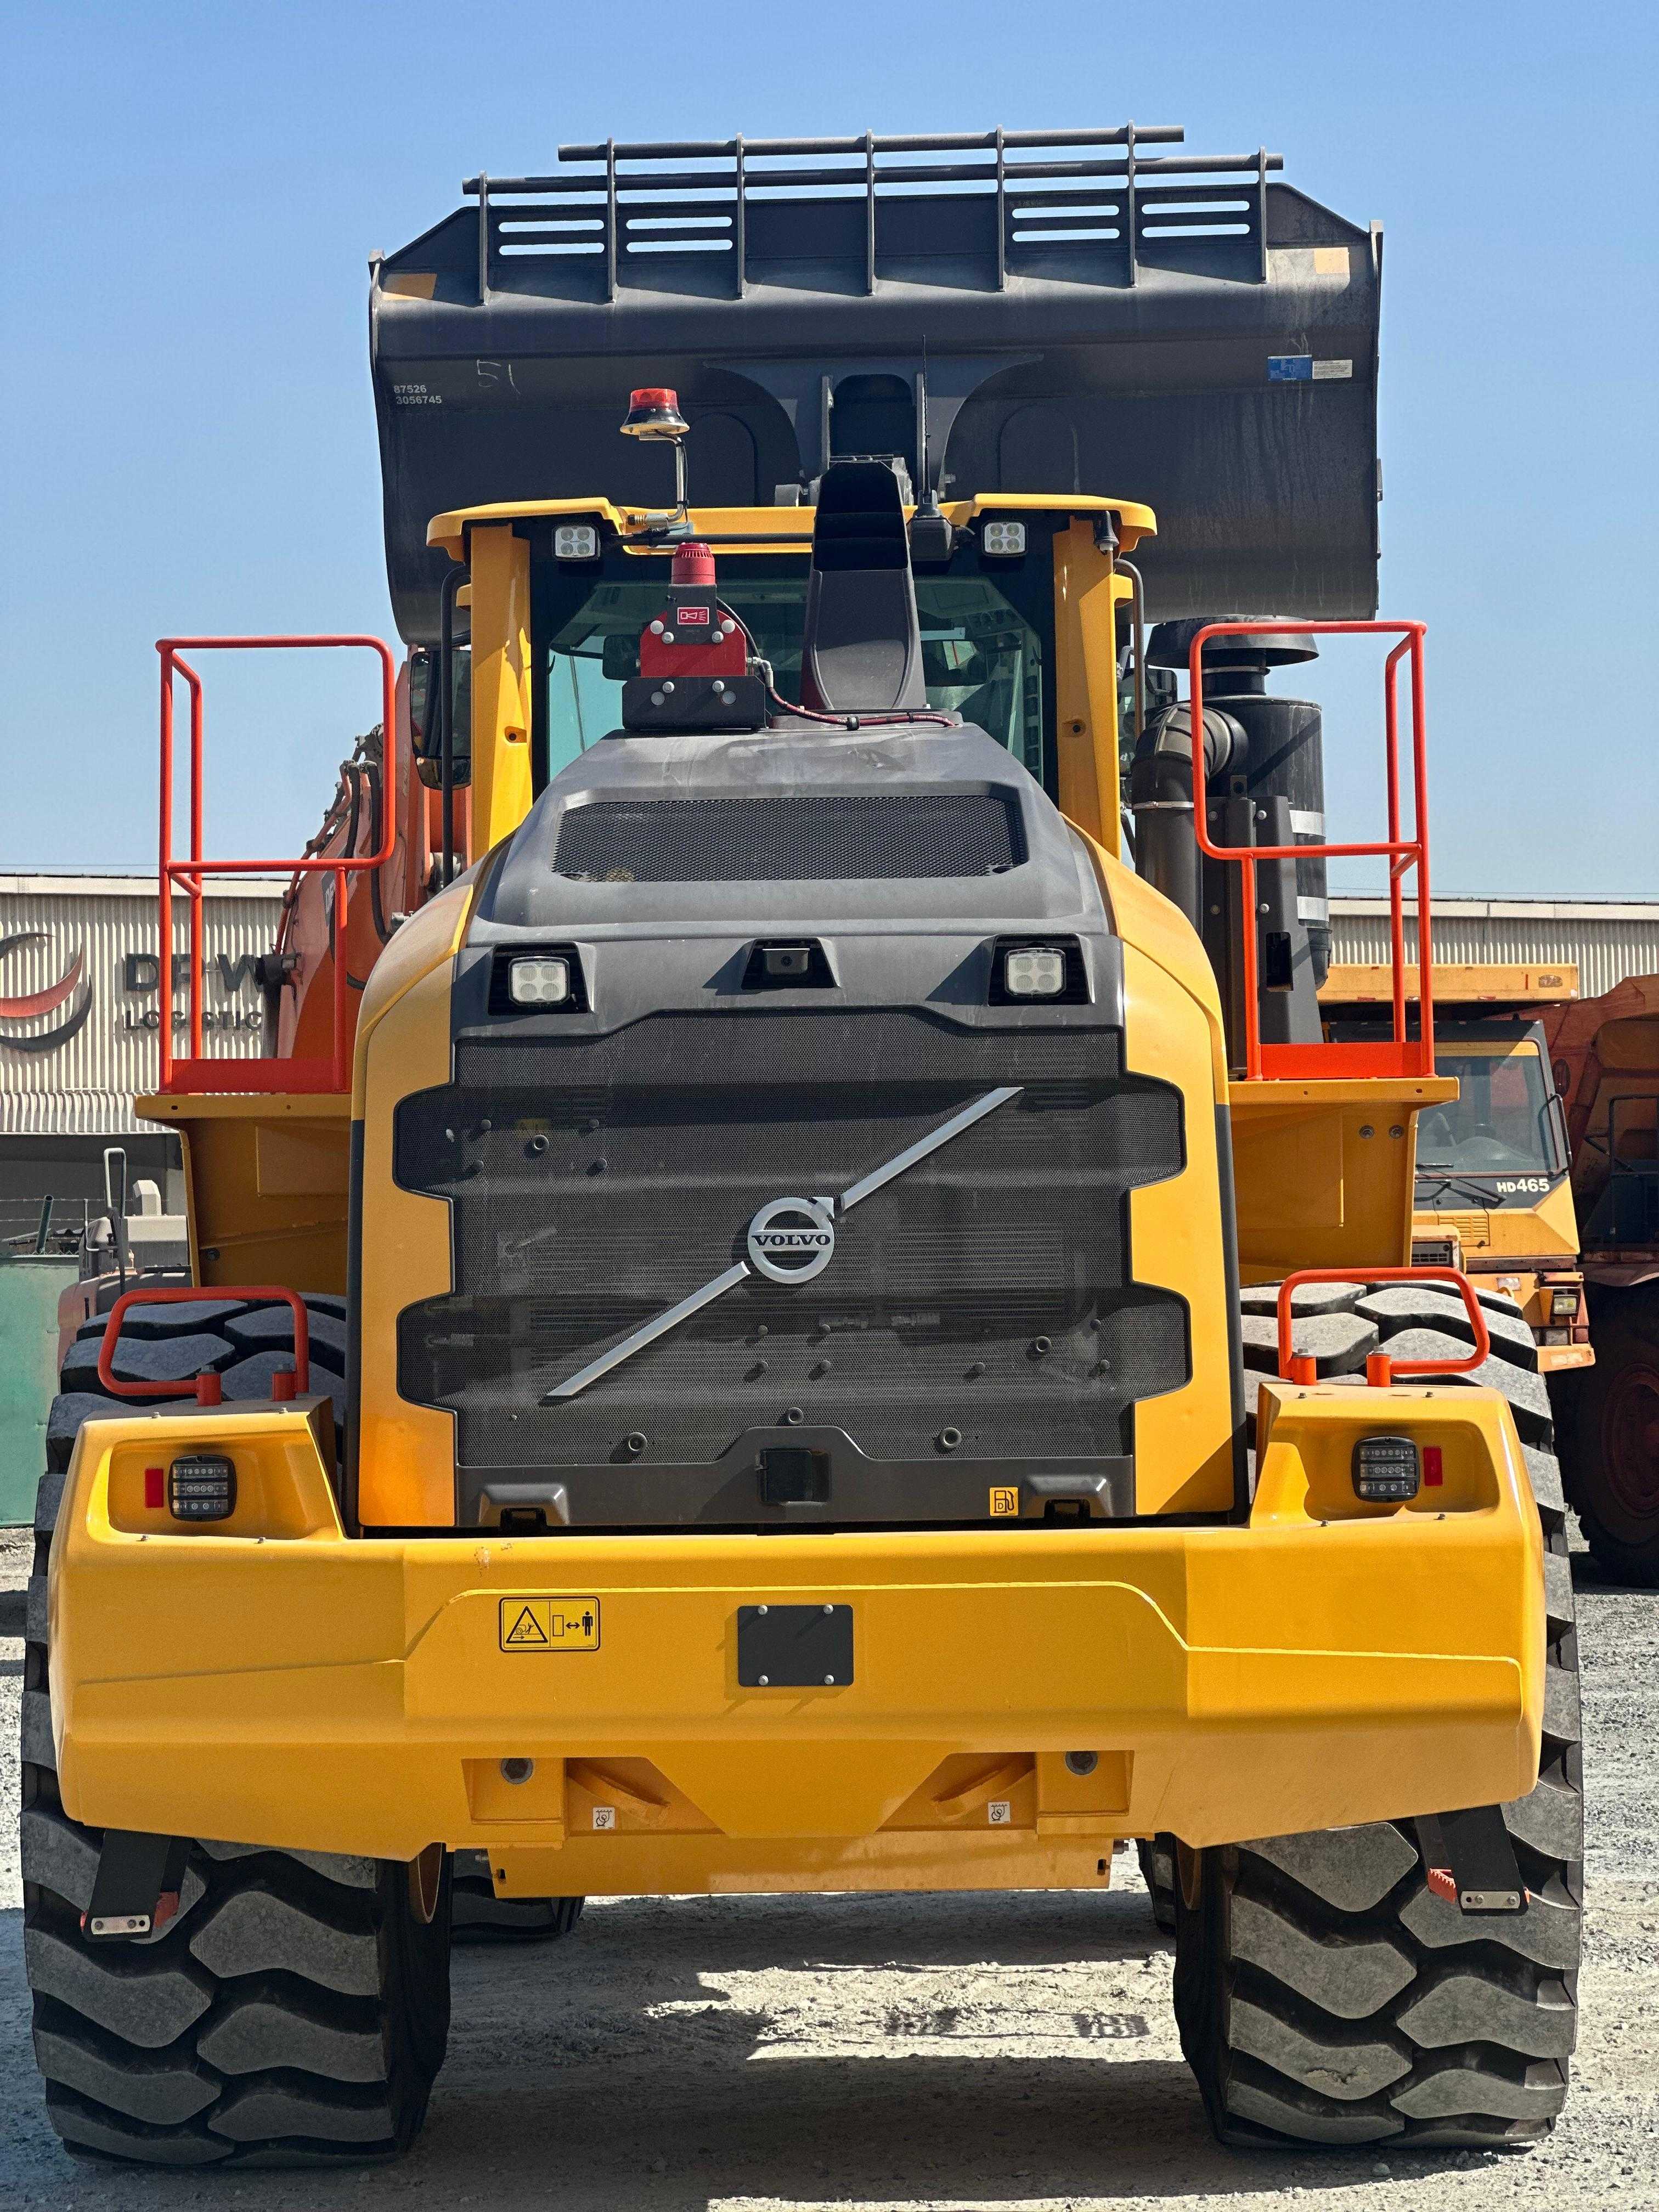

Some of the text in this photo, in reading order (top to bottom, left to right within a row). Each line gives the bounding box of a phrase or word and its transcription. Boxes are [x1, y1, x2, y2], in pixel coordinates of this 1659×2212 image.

[393, 385, 427, 393] 87526
[396, 396, 442, 404] 3056745
[126, 1011, 262, 1030] LOGSTIC
[1496, 1178, 1550, 1192] HD465
[752, 1234, 831, 1246] VOLVO
